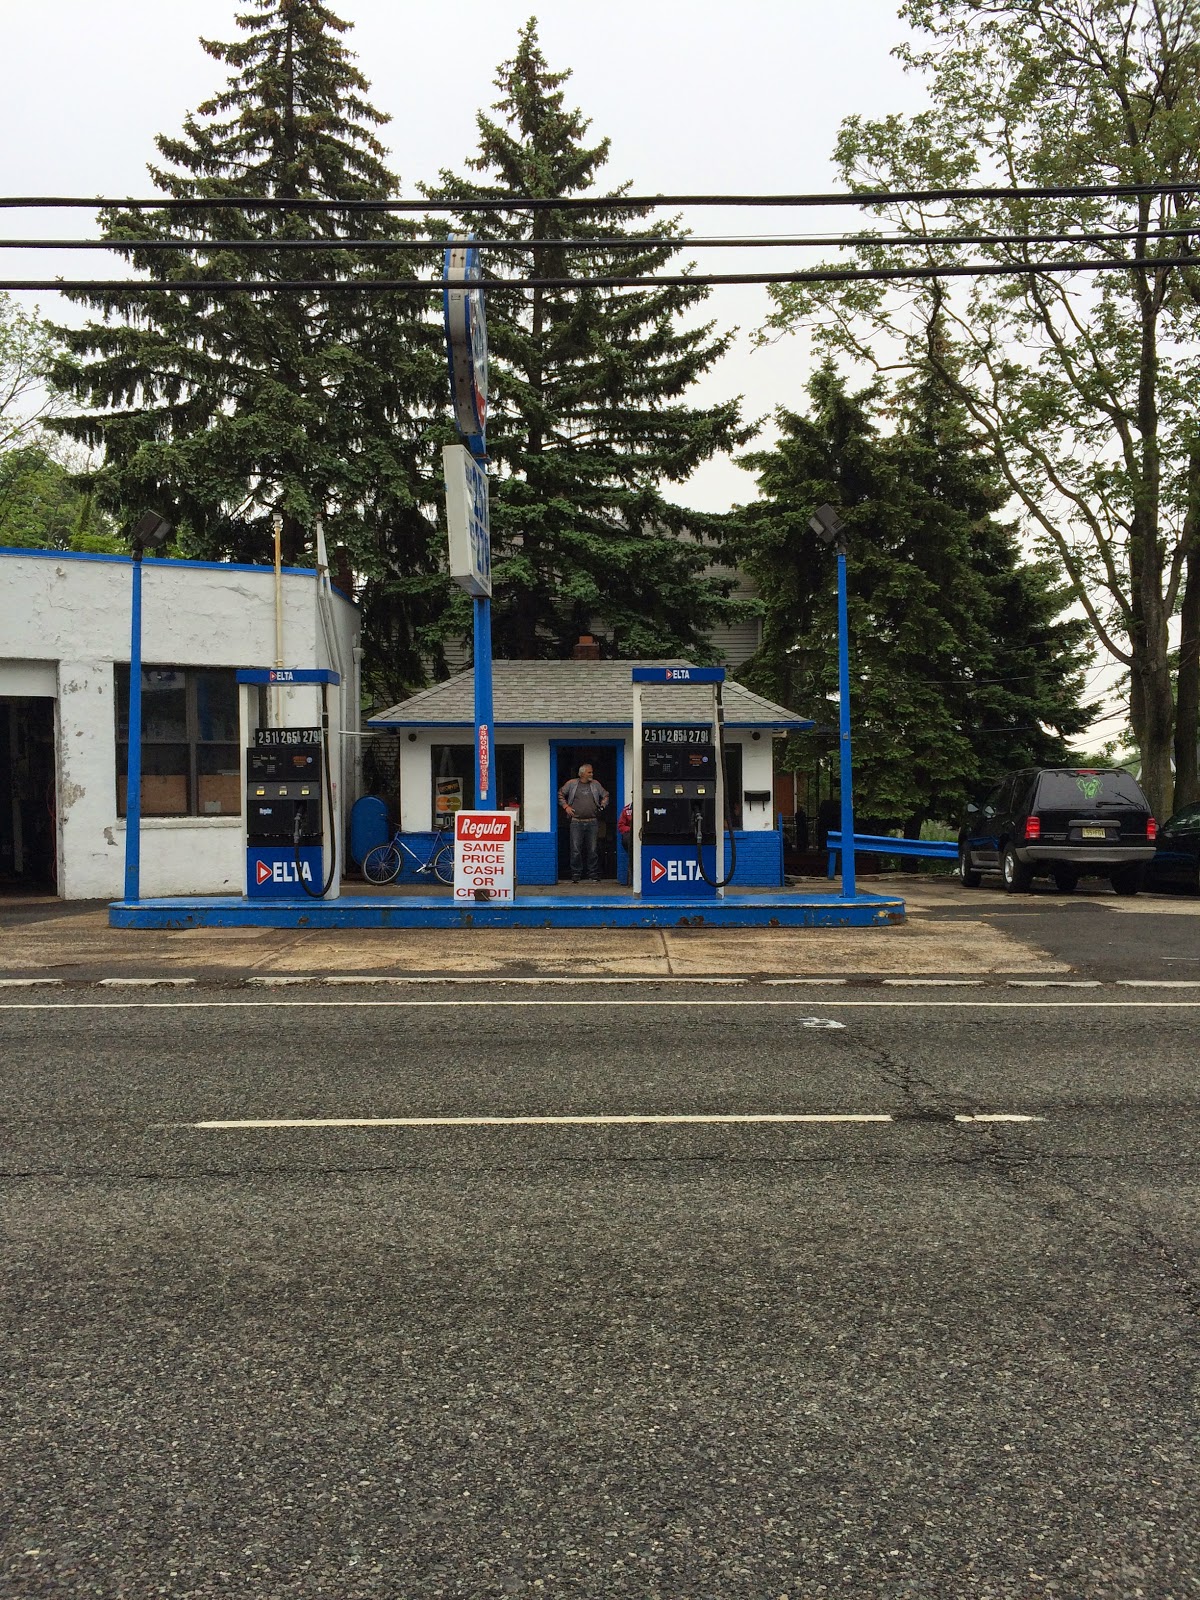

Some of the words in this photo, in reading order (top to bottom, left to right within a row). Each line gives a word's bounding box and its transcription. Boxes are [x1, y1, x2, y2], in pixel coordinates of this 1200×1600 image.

[480, 730, 488, 765] SMOKING
[646, 810, 650, 822] 1
[461, 818, 507, 839] Regular
[463, 843, 504, 852] SAME
[462, 854, 505, 864] PRICE
[463, 866, 504, 875] CASH
[473, 877, 494, 886] OR
[456, 888, 511, 898] CRDIT
